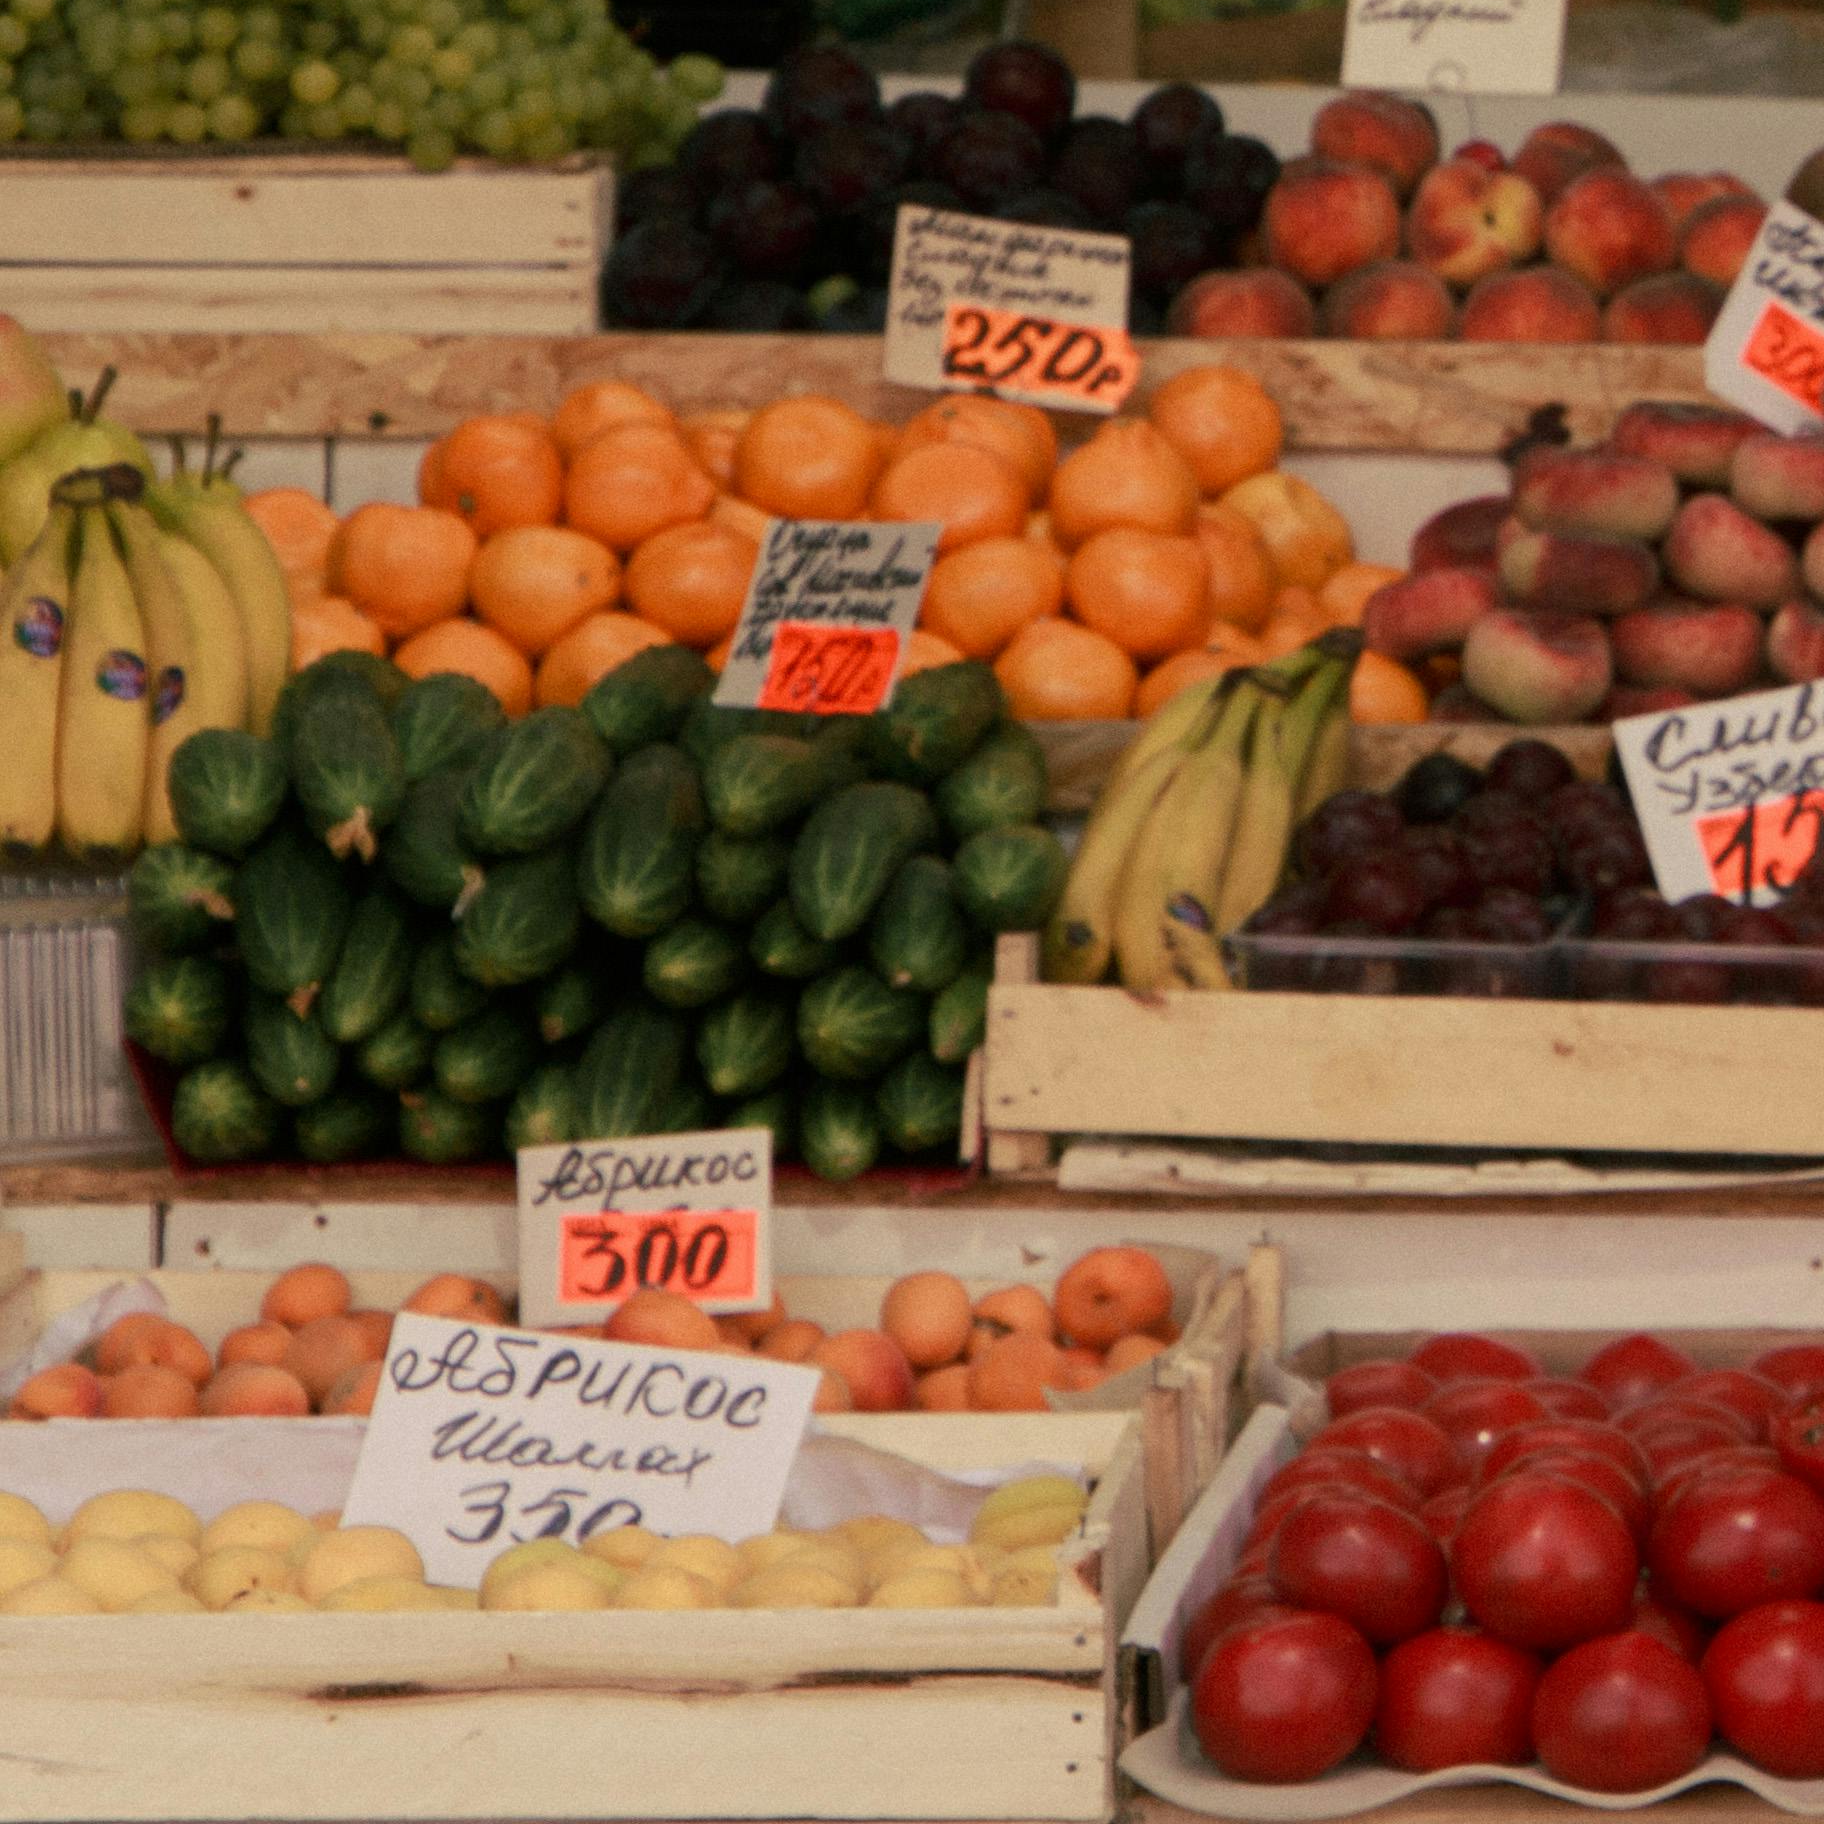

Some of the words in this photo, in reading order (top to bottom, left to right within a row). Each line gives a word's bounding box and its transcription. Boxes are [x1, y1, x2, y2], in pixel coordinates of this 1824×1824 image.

[532, 1146, 758, 1213] Абрикос
[569, 1223, 729, 1296] 300
[391, 1328, 767, 1428] Абрикос
